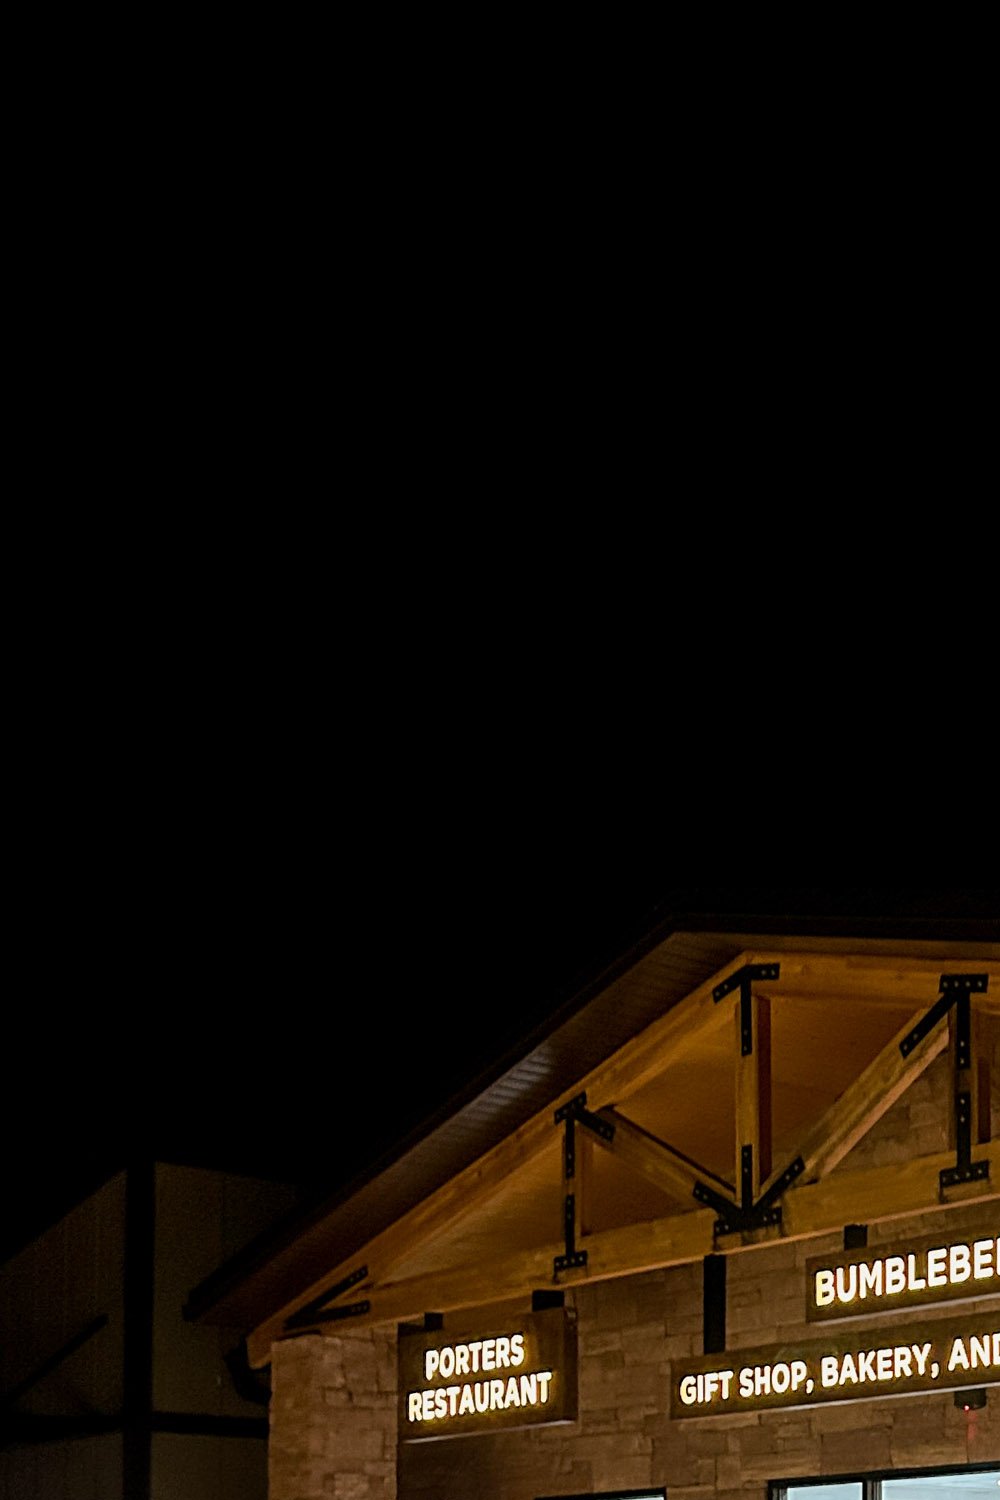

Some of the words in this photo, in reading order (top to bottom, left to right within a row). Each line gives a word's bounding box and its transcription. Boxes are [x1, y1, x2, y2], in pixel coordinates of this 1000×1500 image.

[425, 1334, 525, 1381] PORTERS
[679, 1370, 734, 1405] GIFT
[739, 1360, 814, 1398] SHOP,
[821, 1343, 940, 1388] BAKERY,
[408, 1371, 552, 1422] RESTAURANT
